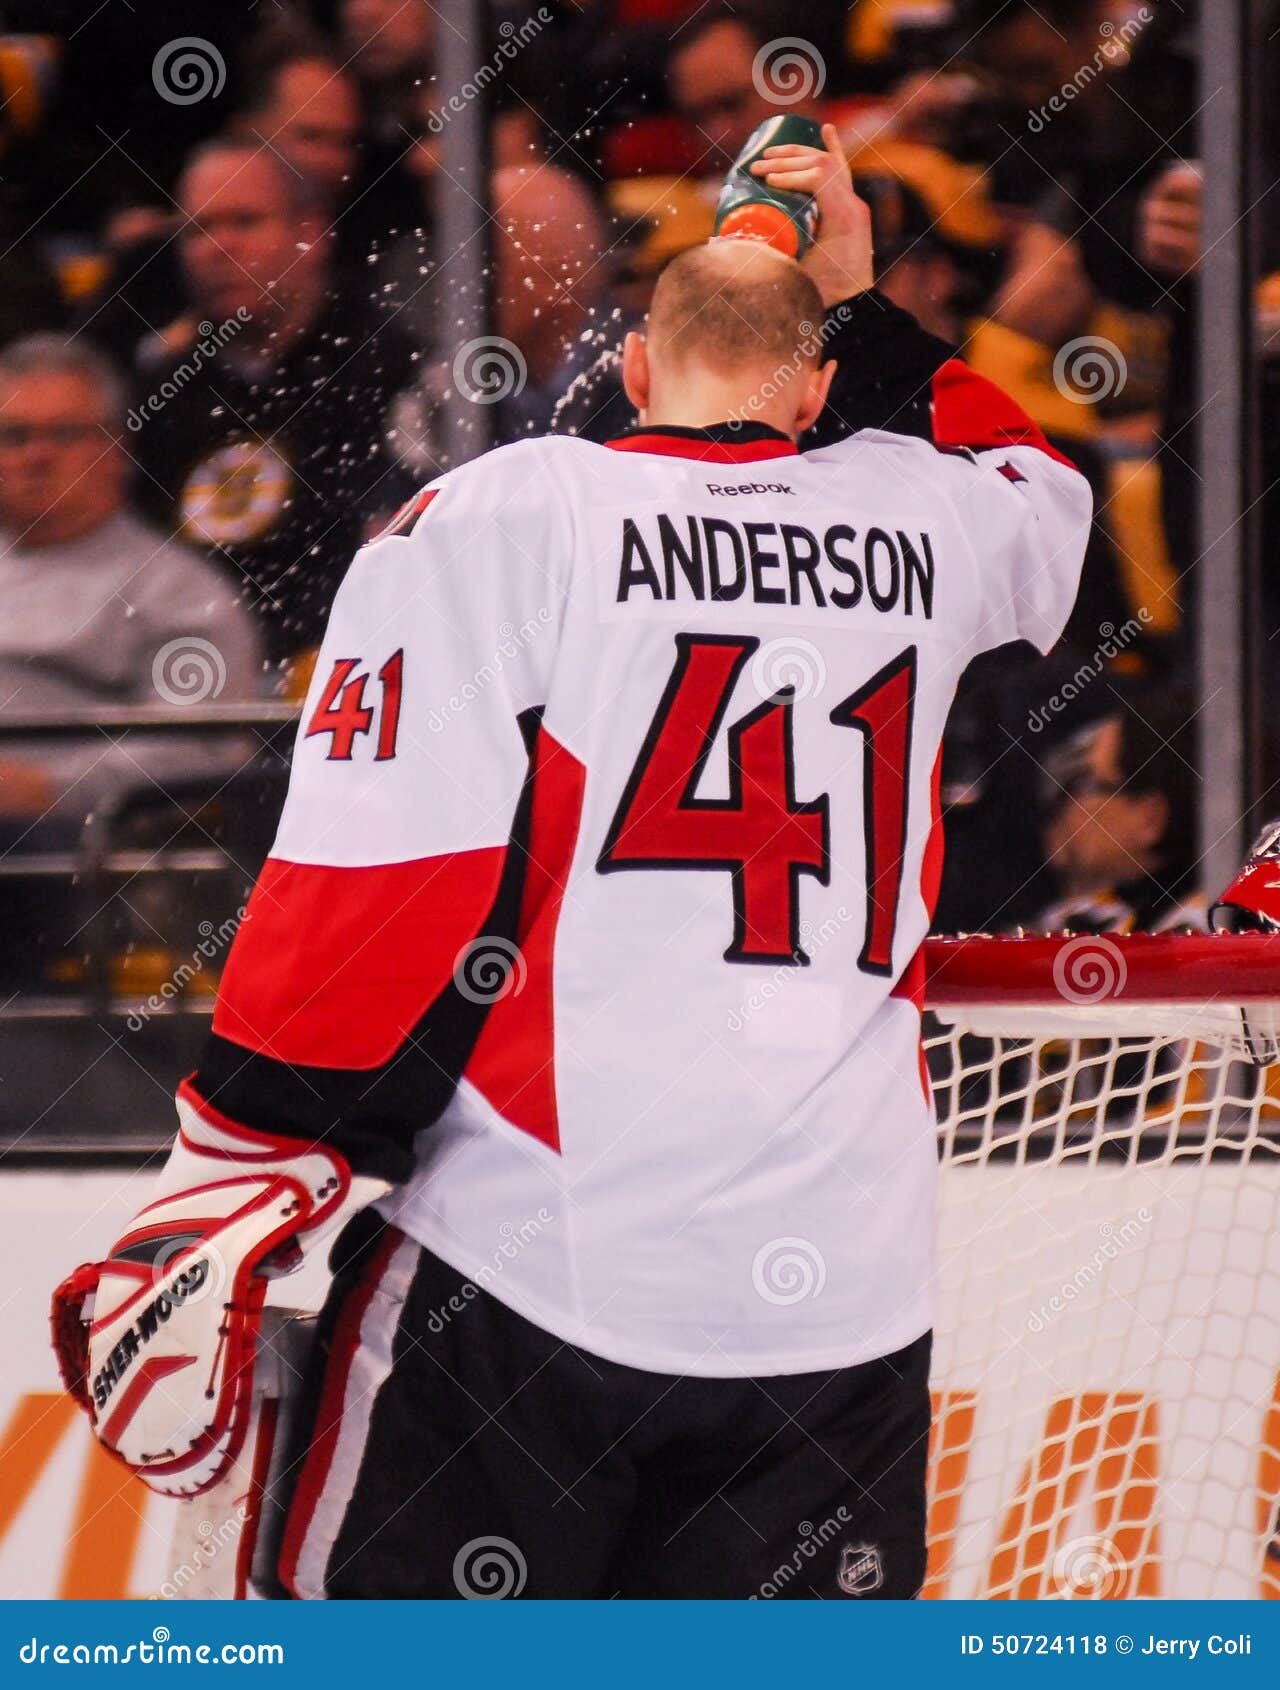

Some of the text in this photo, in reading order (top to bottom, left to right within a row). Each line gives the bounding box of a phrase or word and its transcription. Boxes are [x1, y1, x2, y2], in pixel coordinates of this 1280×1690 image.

[706, 482, 797, 496] Reebok
[616, 513, 935, 620] ANDERSON
[304, 648, 403, 762] 41
[596, 632, 917, 977] 41
[93, 1259, 209, 1410] SHER-WOOD
